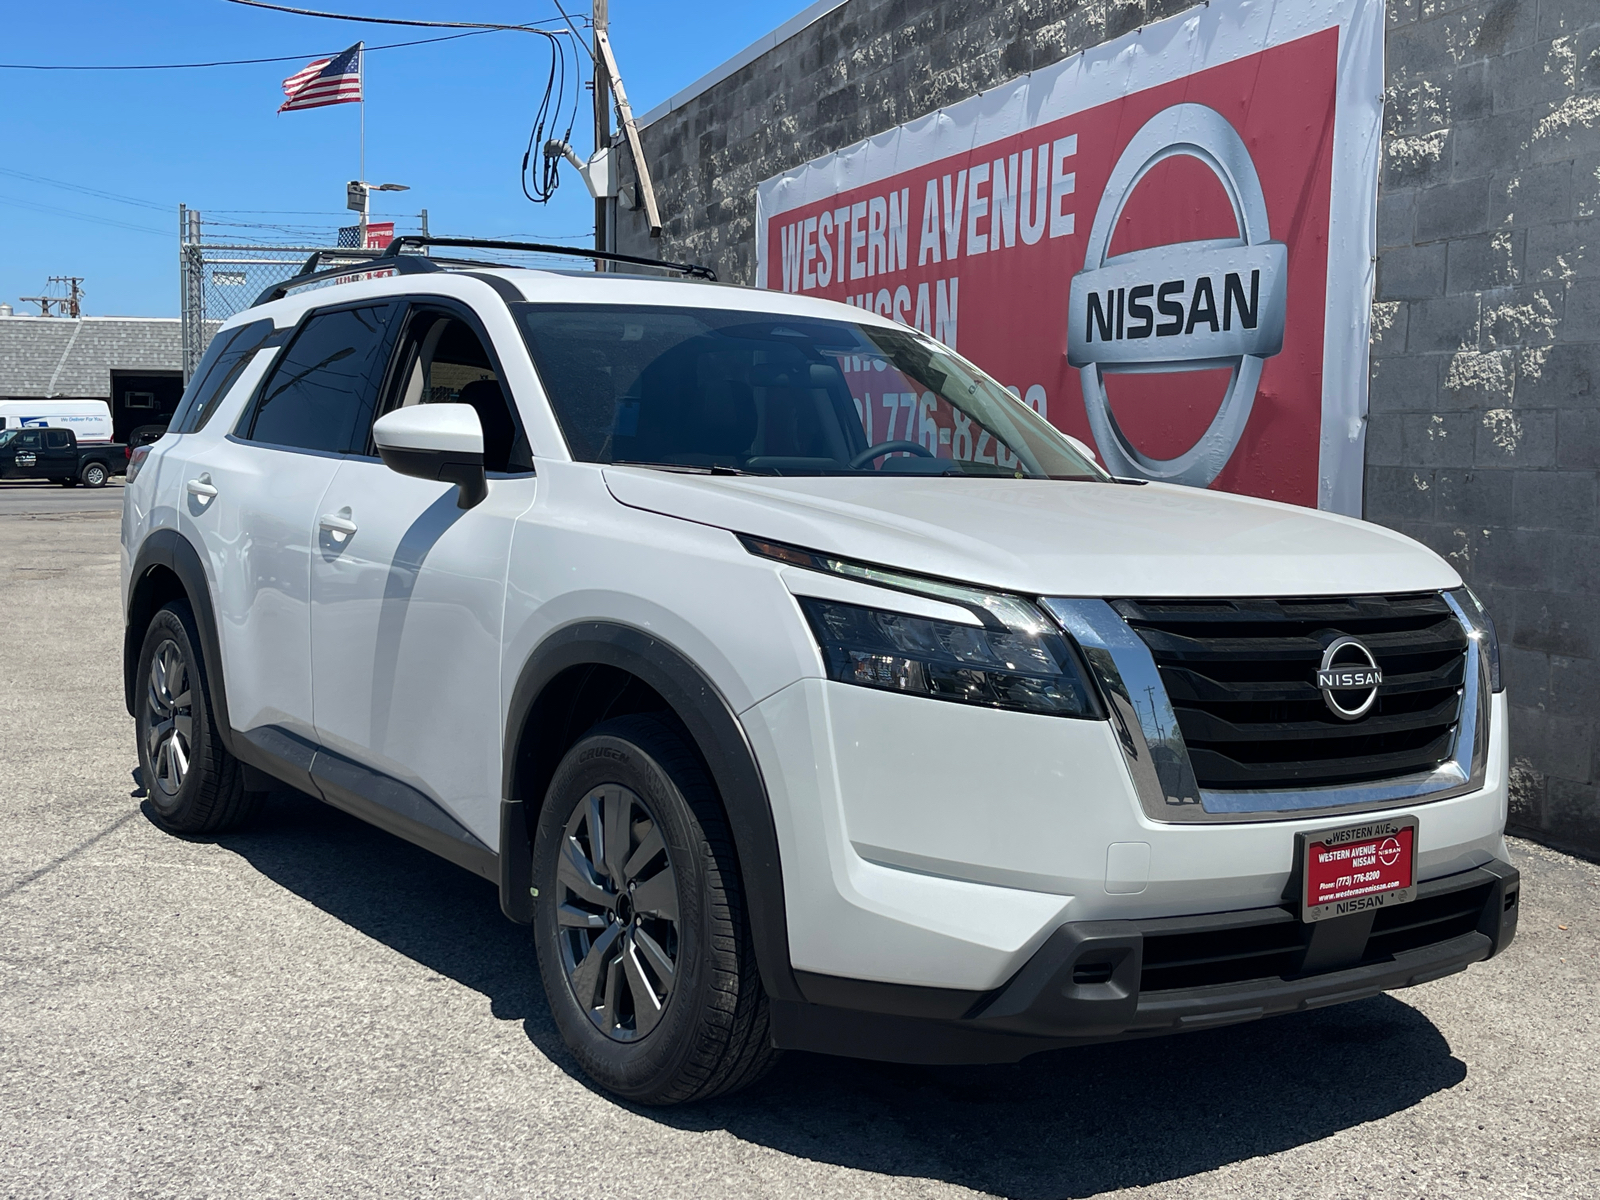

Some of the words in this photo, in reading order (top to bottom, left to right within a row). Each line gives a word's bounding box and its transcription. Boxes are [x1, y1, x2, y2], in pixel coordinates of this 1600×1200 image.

[780, 187, 909, 294] WESTERN
[918, 133, 1078, 267] AVENUE
[1086, 269, 1260, 343] NISSAN
[844, 277, 959, 364] SSAN
[1319, 671, 1382, 687] NISSAN
[579, 746, 631, 765] CRUGEN
[1332, 826, 1373, 843] WESTERN
[1374, 823, 1391, 836] AVE
[1318, 849, 1350, 863] WESTERN
[1351, 844, 1376, 857] AVENUE
[1352, 855, 1376, 868] NISSAN
[1378, 847, 1401, 856] NISSAN
[1319, 882, 1335, 890] Phone:
[1336, 875, 1352, 889] (773)
[1353, 870, 1380, 884] 776-8200
[1318, 881, 1400, 901] www.westernavenissan.com
[1336, 894, 1384, 914] NISSAN
